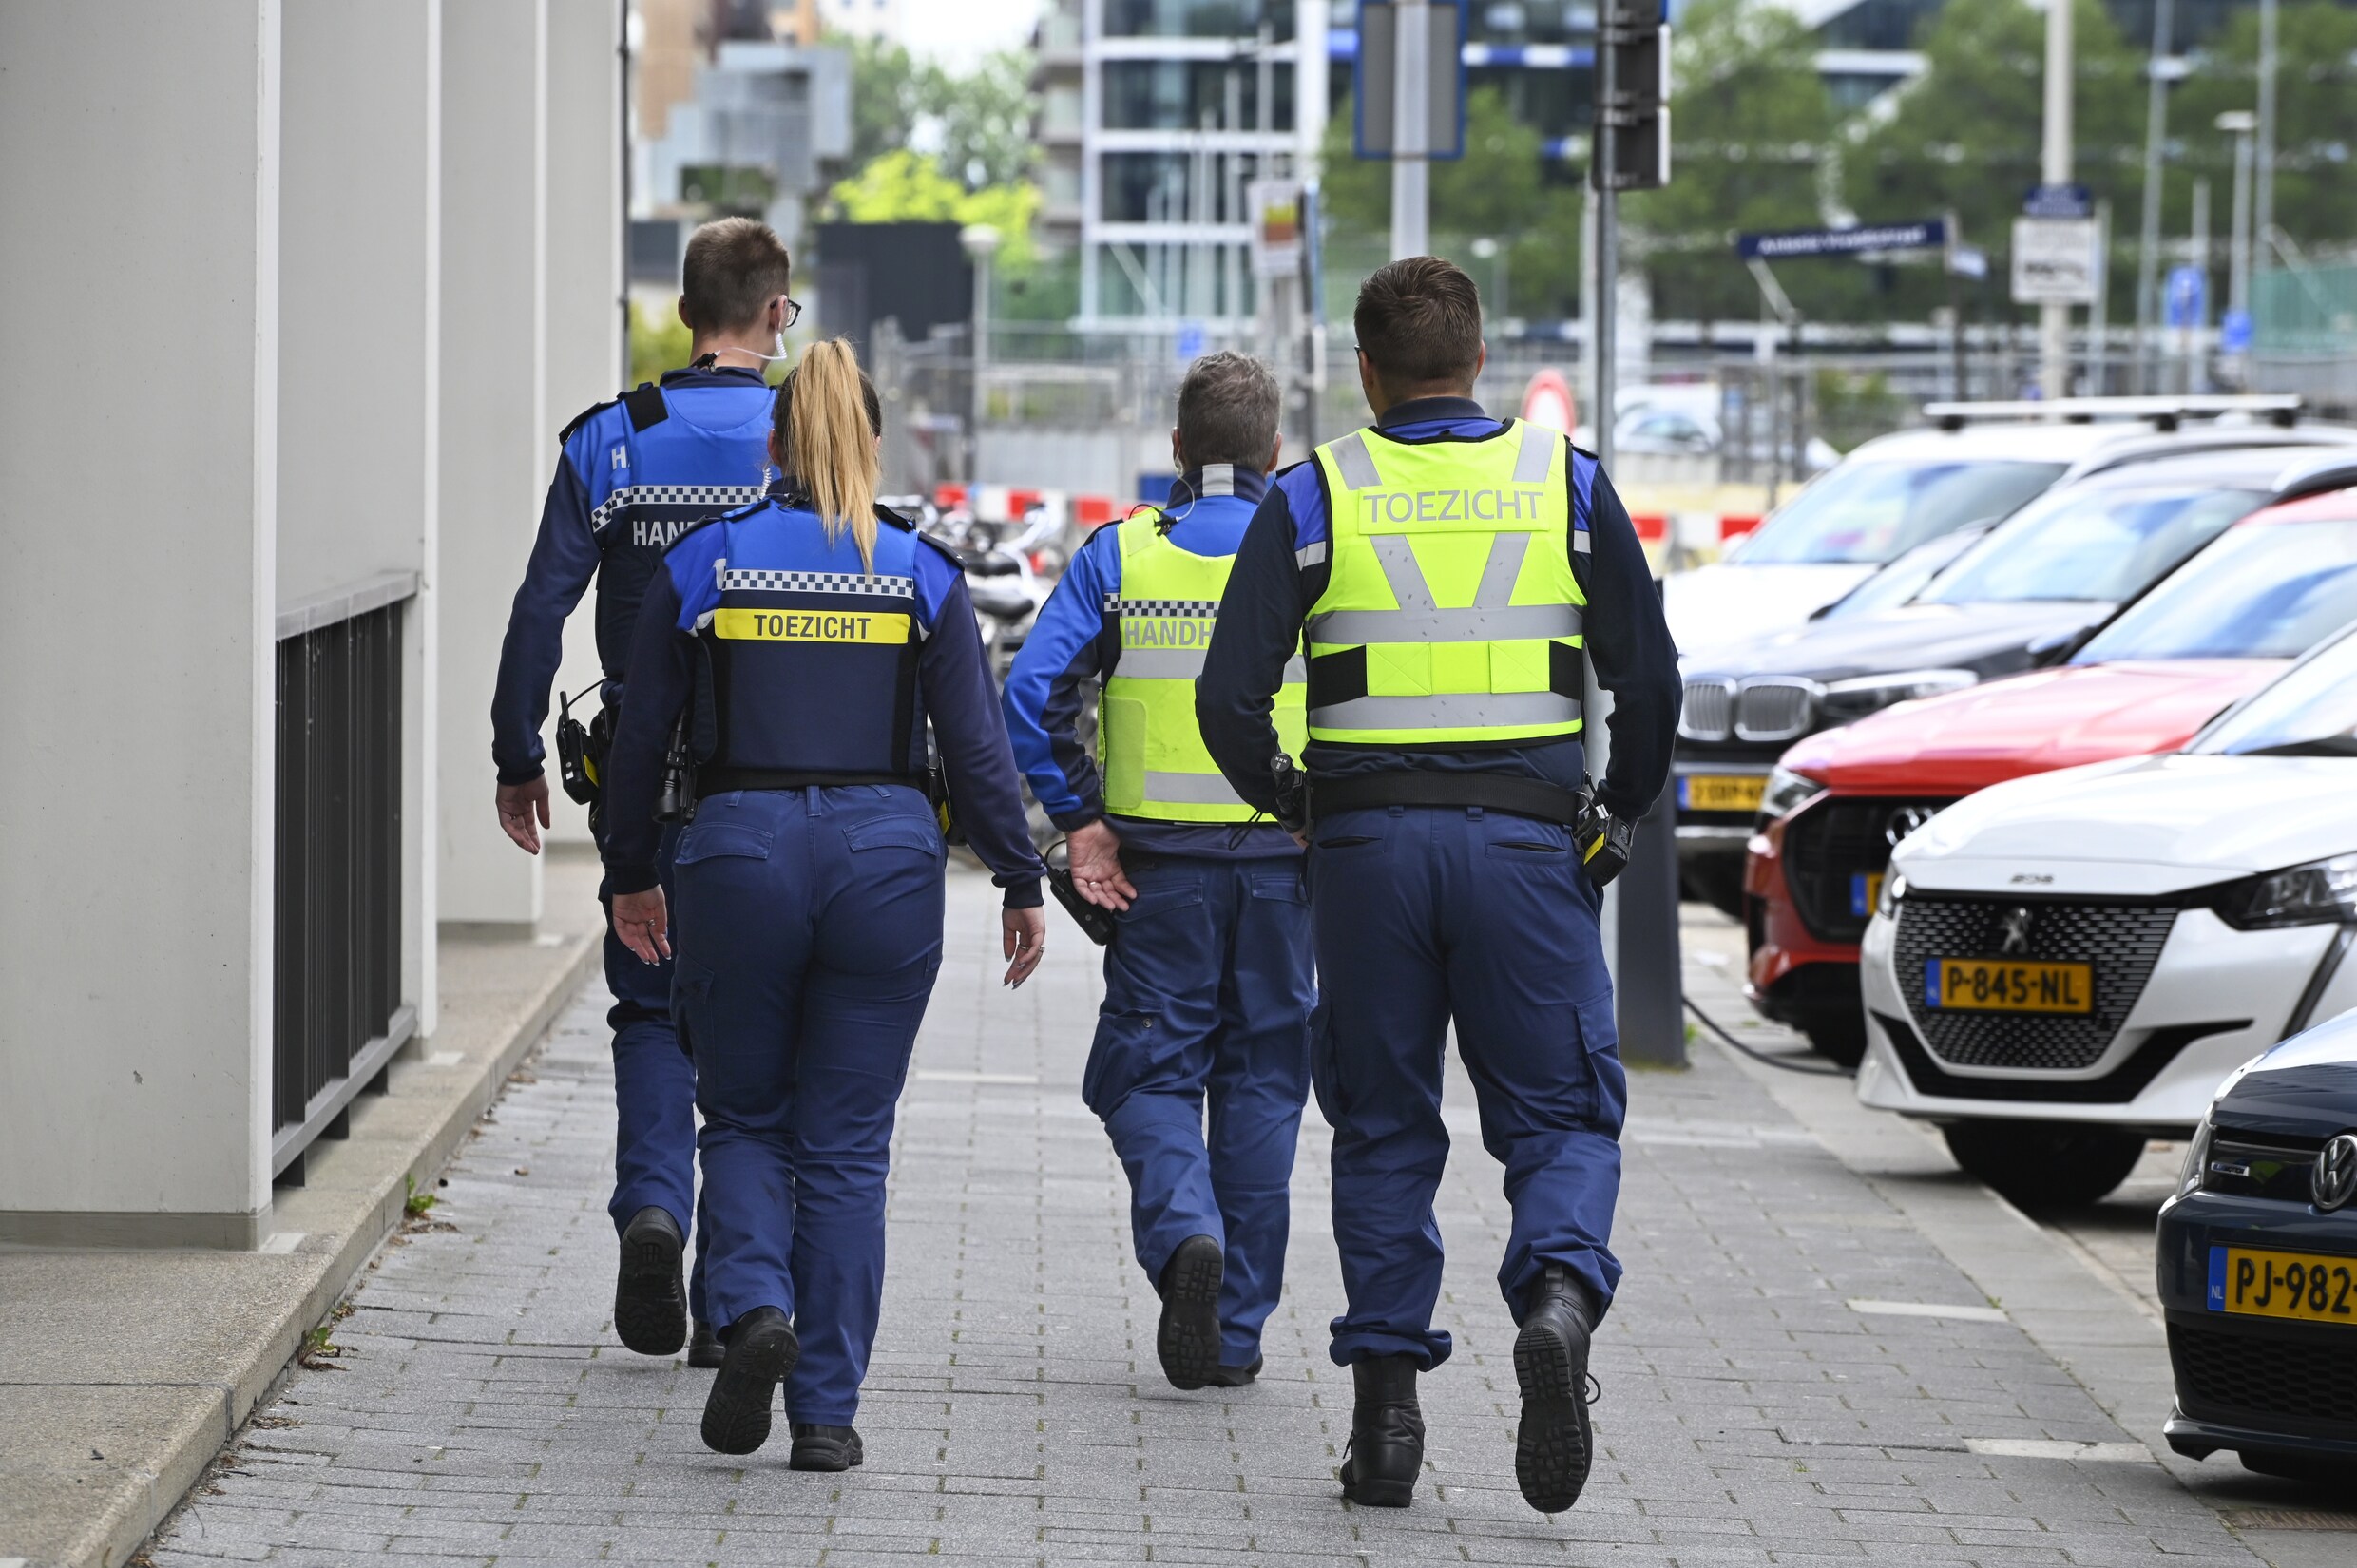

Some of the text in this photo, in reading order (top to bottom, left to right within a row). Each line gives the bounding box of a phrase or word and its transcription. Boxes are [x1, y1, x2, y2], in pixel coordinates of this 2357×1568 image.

[611, 445, 631, 469] H
[1363, 489, 1544, 524] TOEZICHT
[633, 521, 696, 546] HAN
[754, 614, 872, 640] TOEZICHT
[1124, 621, 1215, 647] HANDH
[1949, 966, 2079, 1005] P-845-NL
